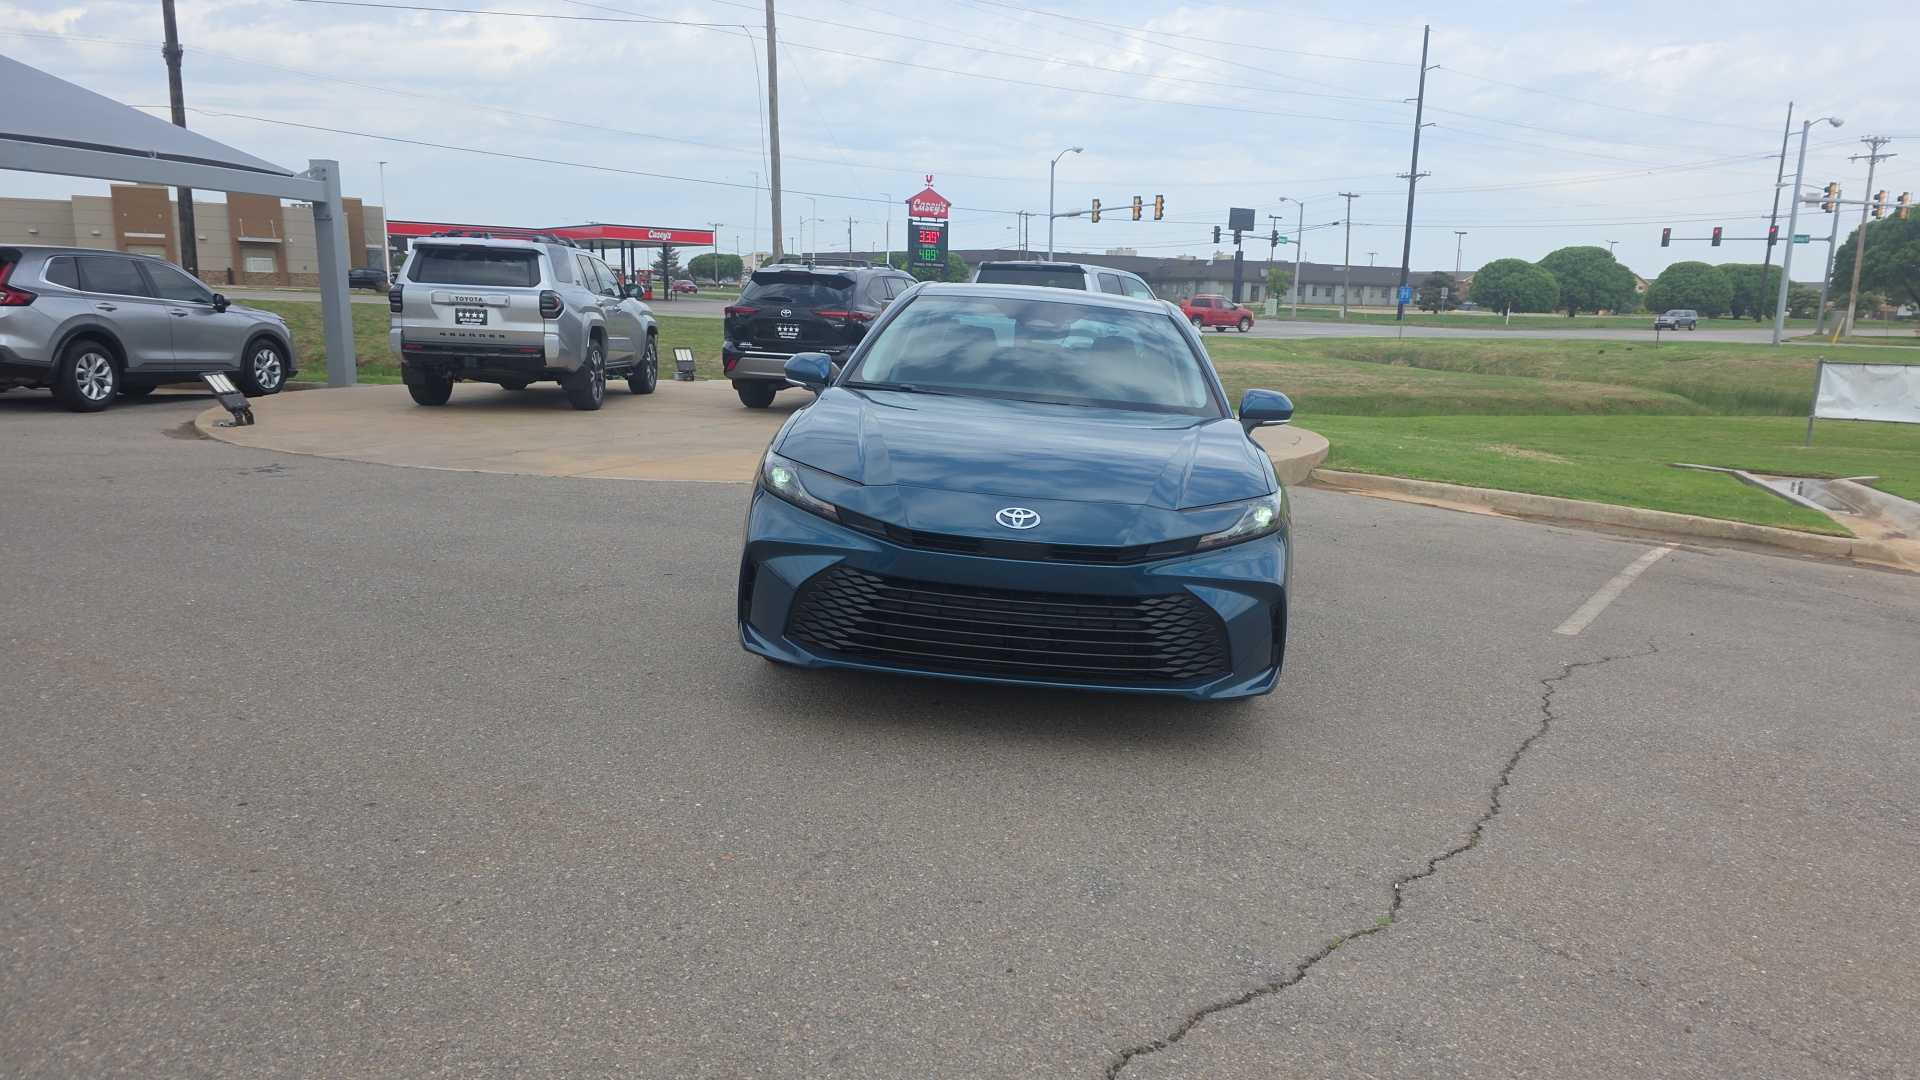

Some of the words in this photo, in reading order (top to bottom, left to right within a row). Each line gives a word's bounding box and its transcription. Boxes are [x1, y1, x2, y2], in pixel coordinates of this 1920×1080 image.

[913, 199, 947, 215] Casey's
[648, 230, 672, 240] Casey's
[1401, 289, 1410, 298] H
